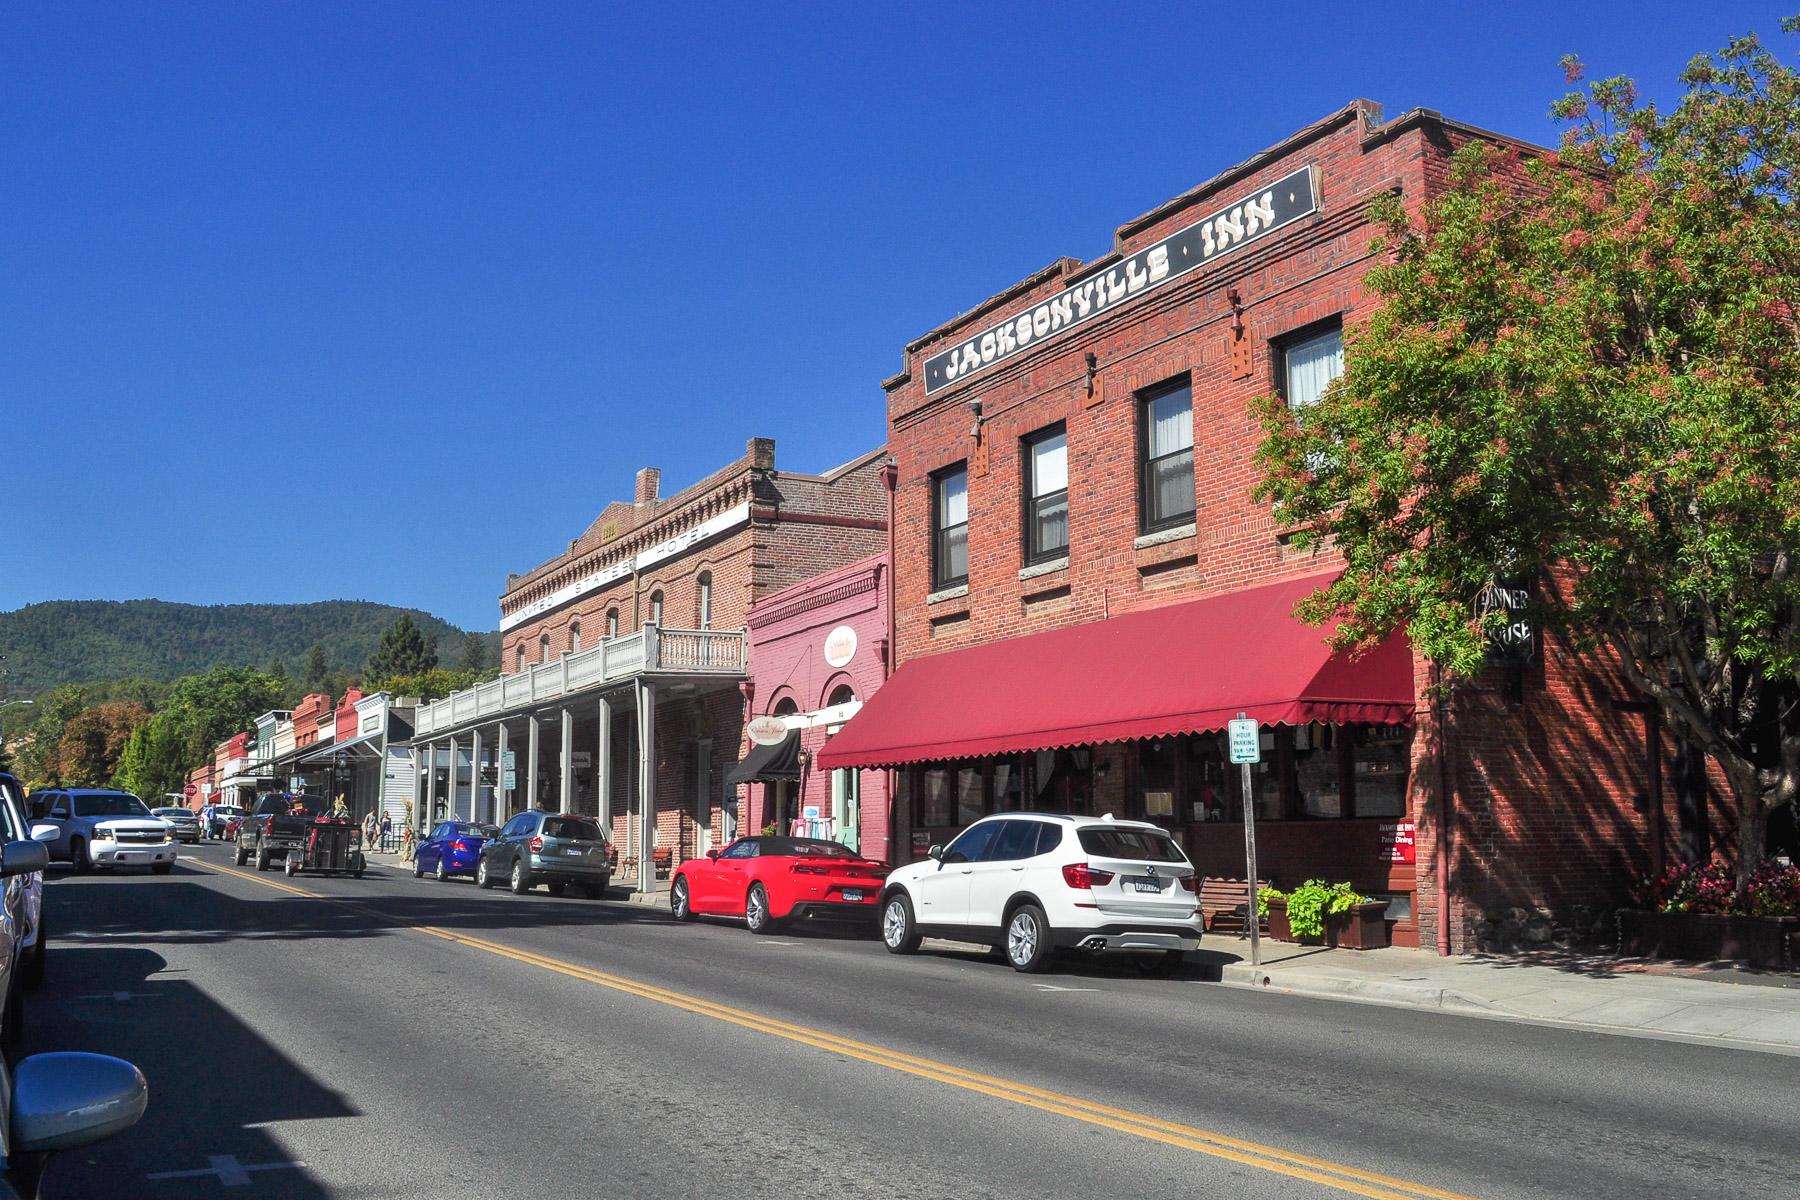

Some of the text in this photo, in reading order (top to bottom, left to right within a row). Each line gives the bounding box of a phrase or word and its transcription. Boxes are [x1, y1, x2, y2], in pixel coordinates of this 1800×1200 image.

[945, 191, 1276, 380] JACKSONVILLE INN
[514, 596, 555, 622] UNITED
[575, 561, 629, 594] STATES
[656, 526, 710, 559] HOTEL
[1395, 836, 1413, 845] Dining
